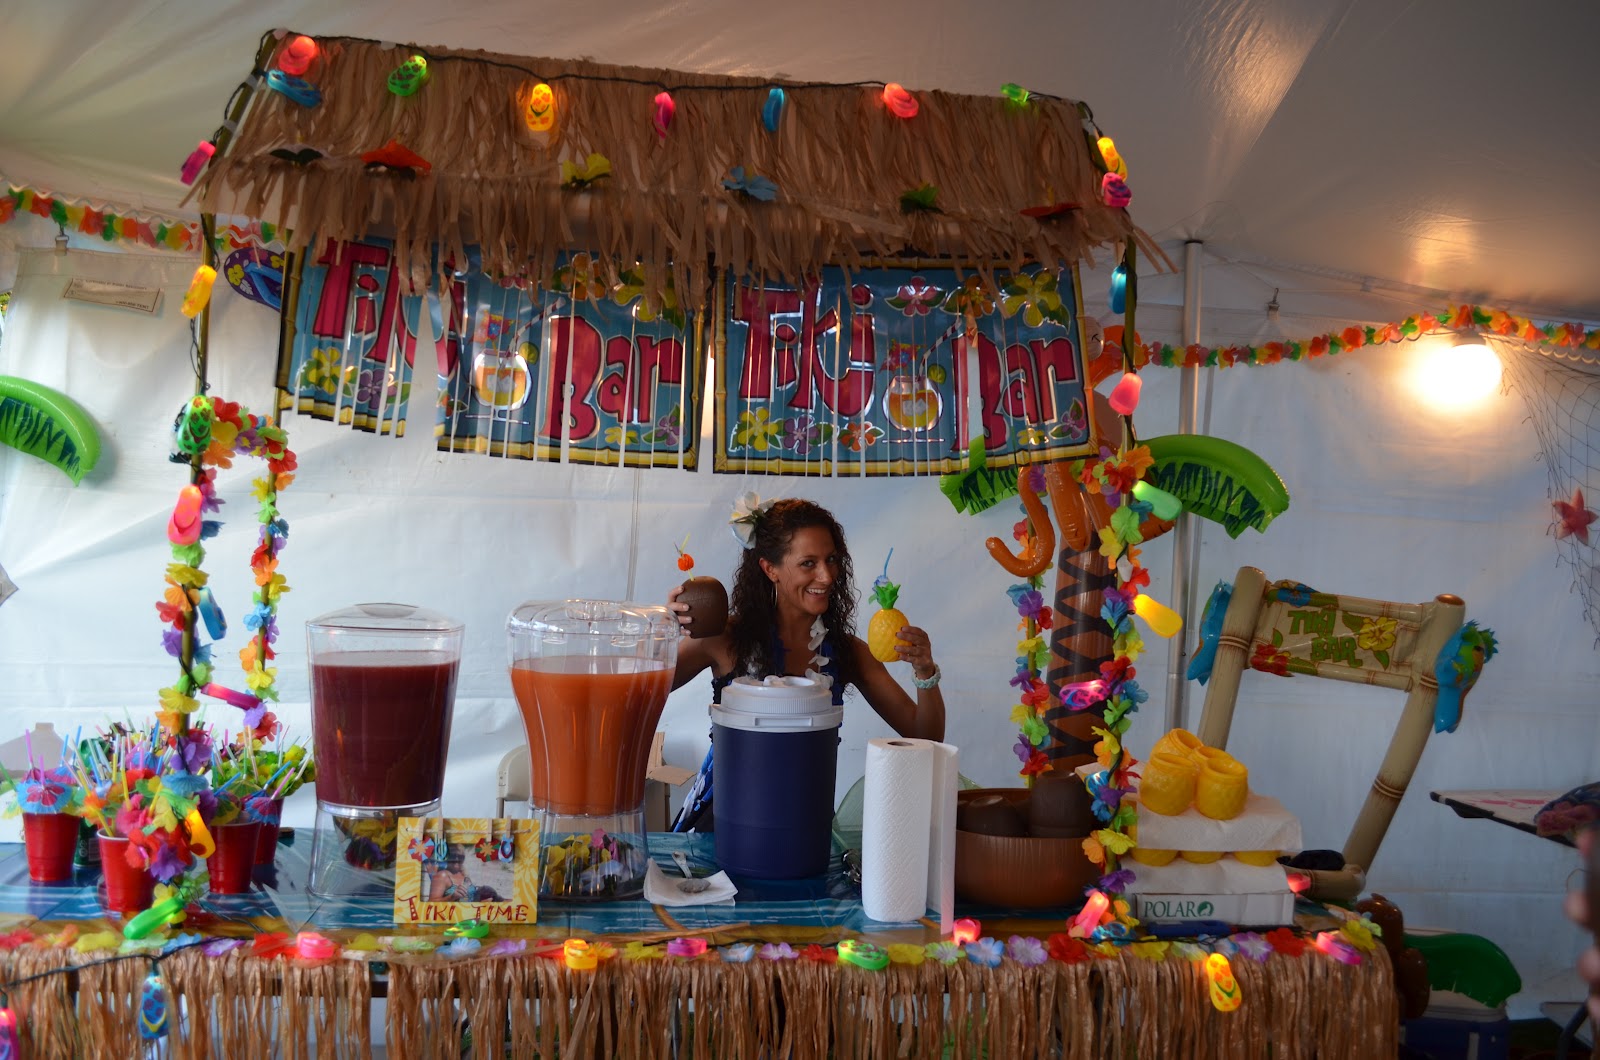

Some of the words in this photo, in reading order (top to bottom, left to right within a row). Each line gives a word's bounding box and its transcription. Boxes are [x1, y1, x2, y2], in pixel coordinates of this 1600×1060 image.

[731, 270, 876, 417] Tiki
[951, 331, 1079, 452] Bar
[540, 314, 684, 441] Bar
[1288, 608, 1337, 637] TIKI
[1309, 636, 1363, 668] BAR
[398, 895, 457, 922] TIKI
[471, 903, 529, 922] TIME
[1144, 901, 1197, 918] POLAR
